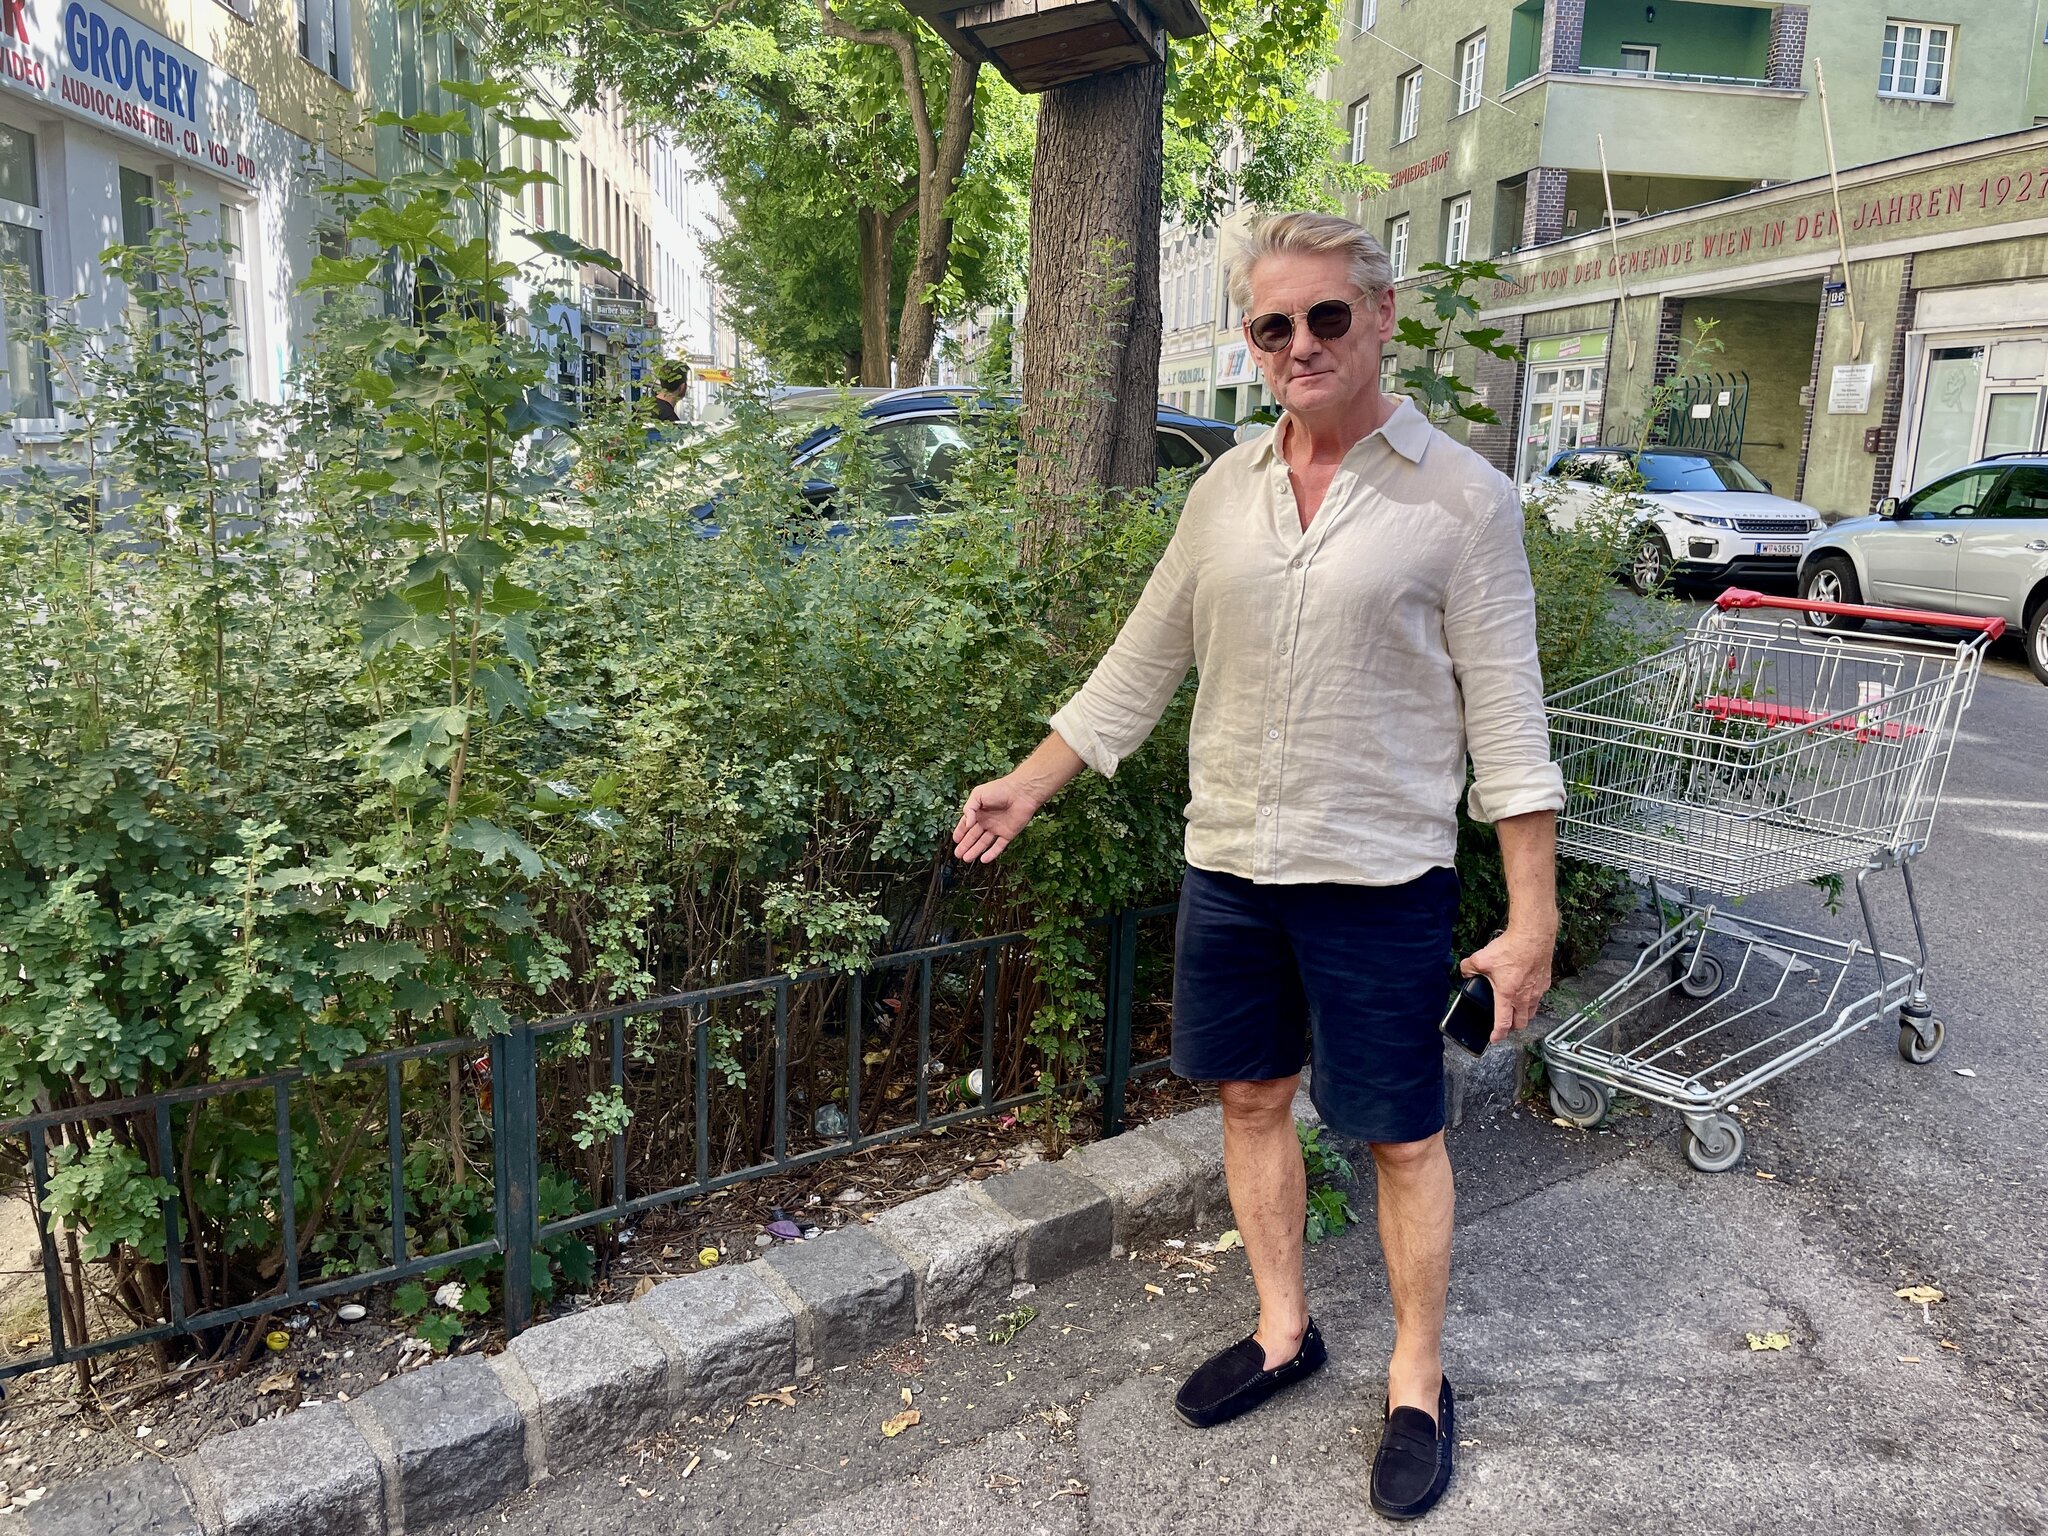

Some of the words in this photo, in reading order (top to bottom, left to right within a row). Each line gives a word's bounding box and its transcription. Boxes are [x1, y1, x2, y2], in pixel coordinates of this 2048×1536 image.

[0, 0, 30, 45] R
[65, 2, 198, 122] GROCERY
[62, 74, 174, 145] AUDIOCASSETTEN
[184, 129, 198, 155] CD
[208, 139, 228, 168] VCD
[237, 153, 255, 179] DVD
[1388, 151, 1450, 189] CHMIEDEL-HOF
[1492, 272, 1538, 299] ERBAUT
[1541, 266, 1568, 289] VON
[1573, 260, 1601, 284] DER
[1608, 240, 1693, 277] GEMEINDE
[1702, 226, 1751, 259] WIEN
[1762, 220, 1785, 247] IN
[1795, 209, 1839, 242] DEN
[1853, 183, 1964, 231] JAHREN
[1978, 167, 2048, 208] 1927
